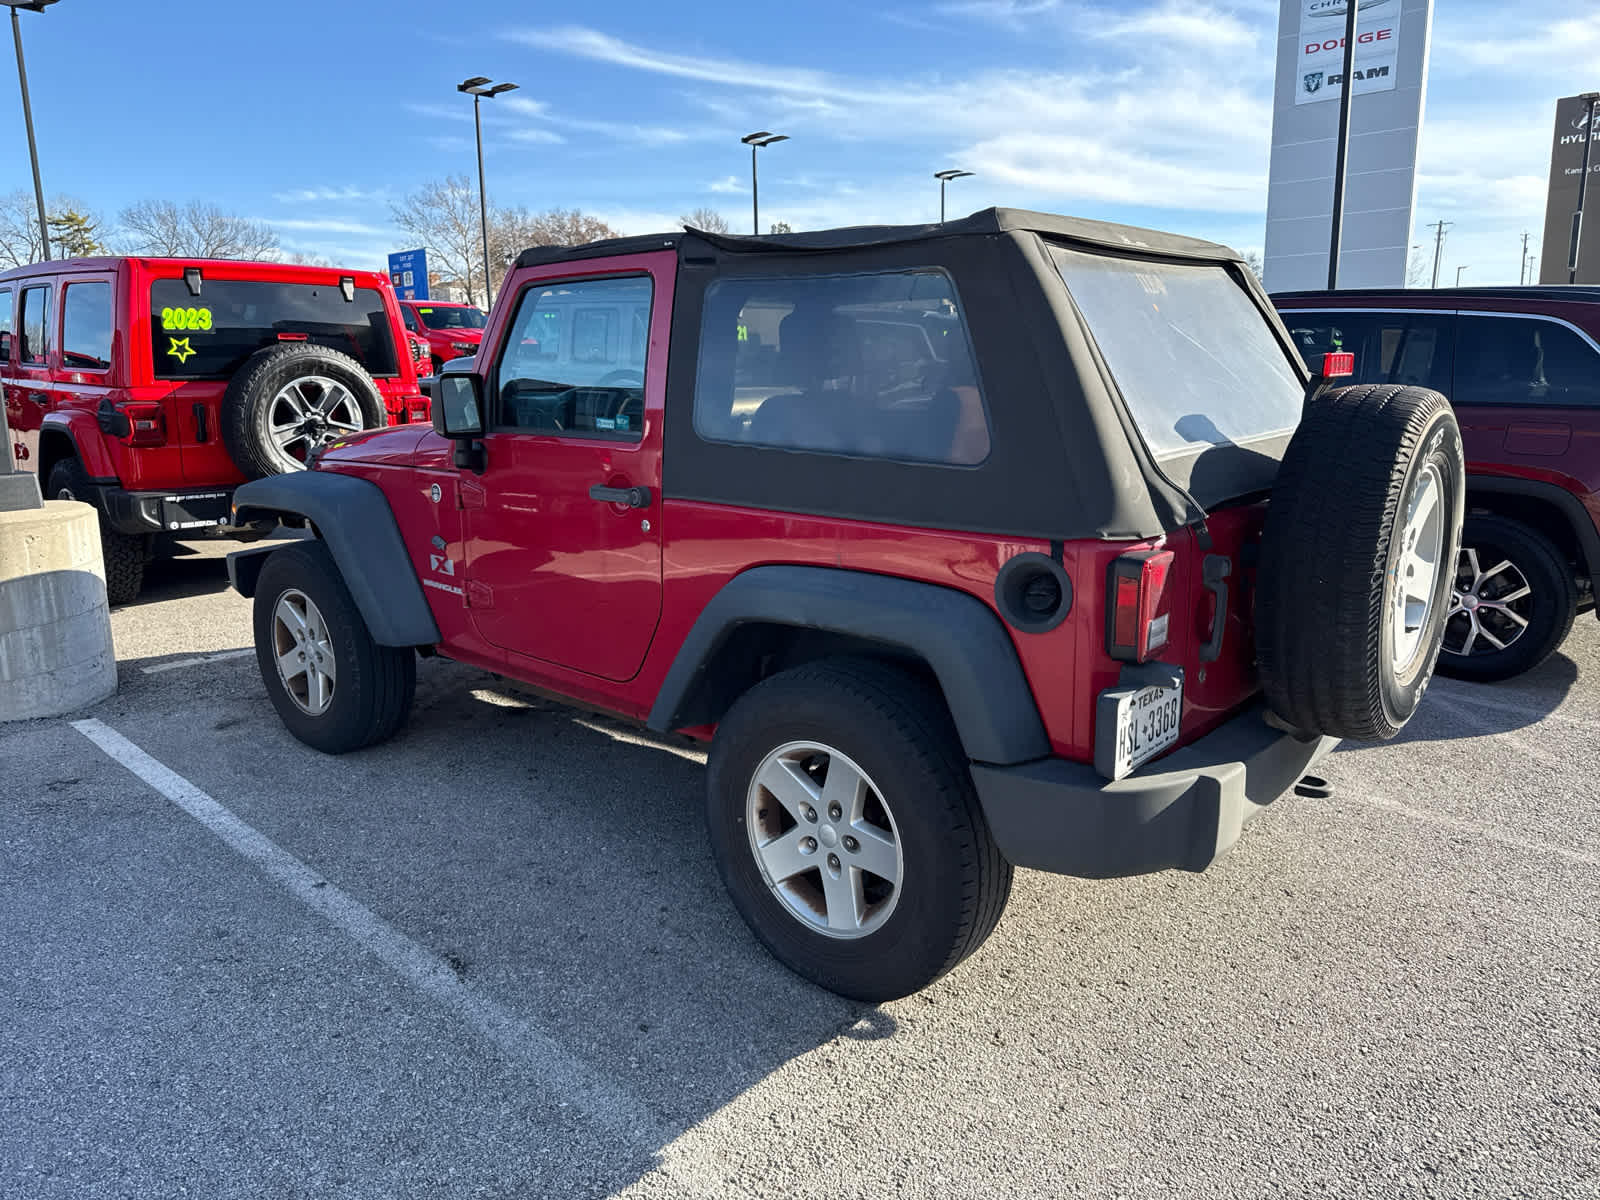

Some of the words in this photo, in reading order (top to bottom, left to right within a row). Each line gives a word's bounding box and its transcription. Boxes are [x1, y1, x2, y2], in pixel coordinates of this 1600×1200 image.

[1327, 66, 1389, 85] RAM
[161, 307, 213, 331] 2023
[1137, 687, 1164, 710] TEXAS
[1118, 717, 1141, 763] HSL
[1147, 697, 1177, 743] 3368
